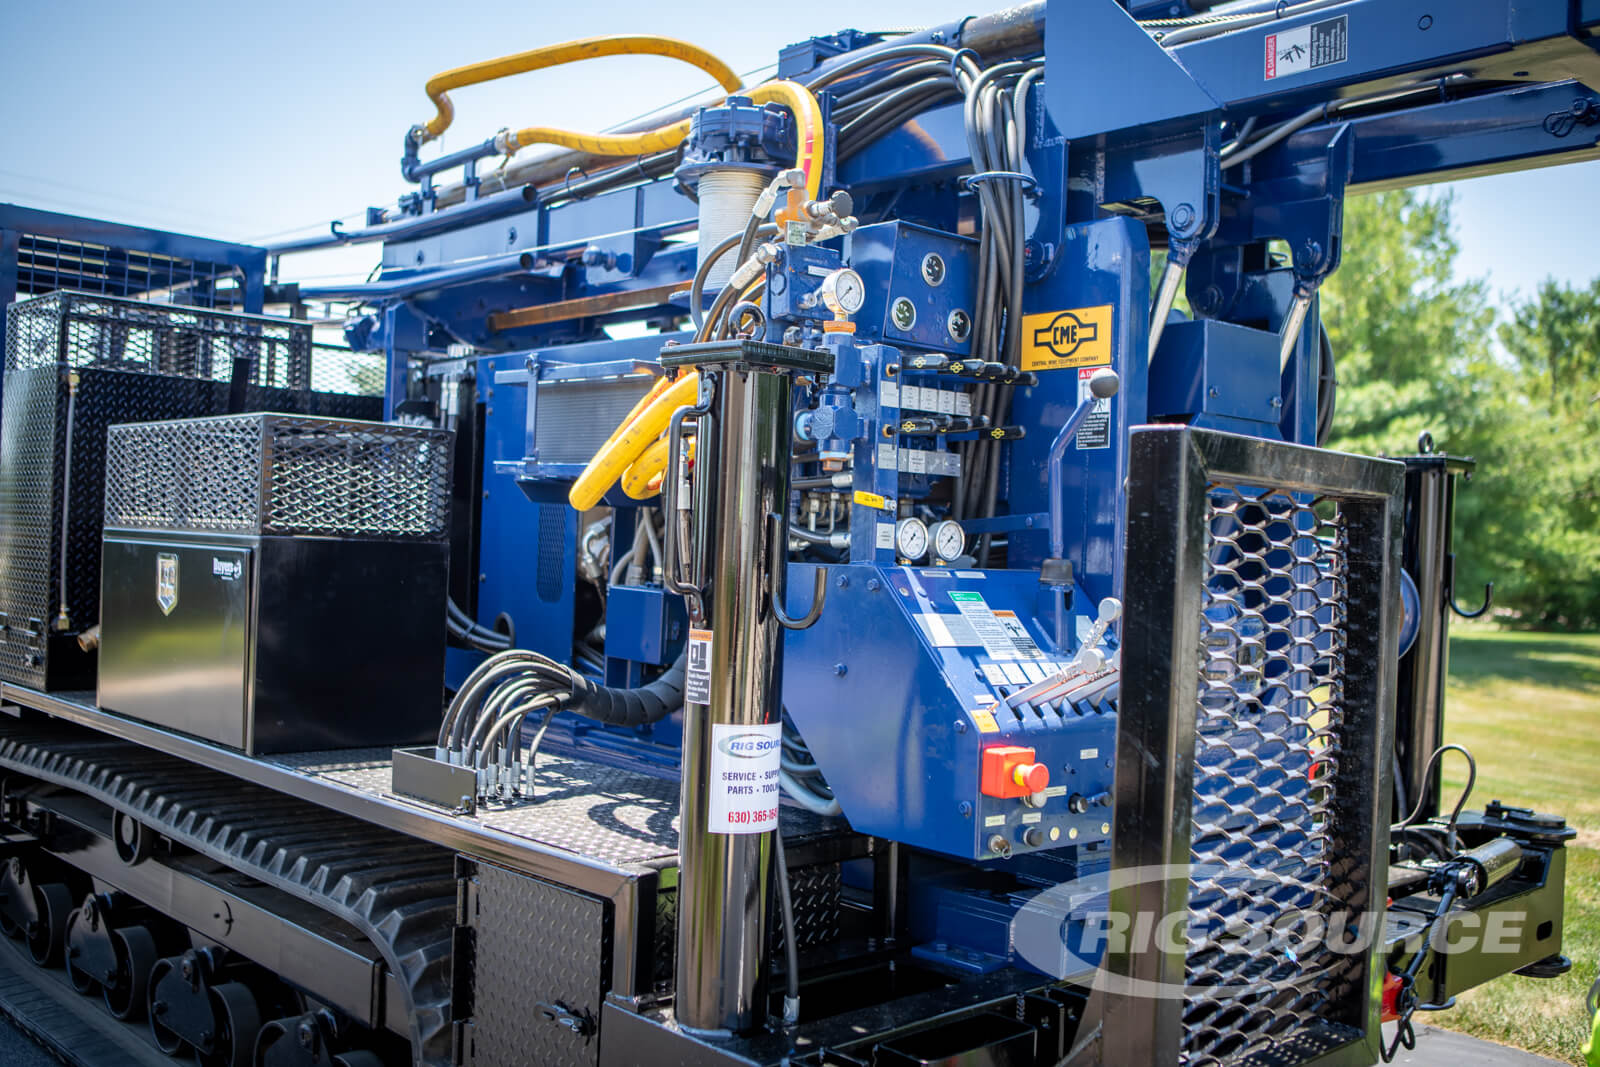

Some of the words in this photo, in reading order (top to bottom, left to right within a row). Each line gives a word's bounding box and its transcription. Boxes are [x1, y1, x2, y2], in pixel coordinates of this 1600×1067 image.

[1267, 37, 1275, 69] DANGER
[1053, 325, 1077, 345] CME
[730, 741, 754, 751] RIG
[722, 772, 757, 781] SERVICE
[727, 786, 754, 795] PARTS
